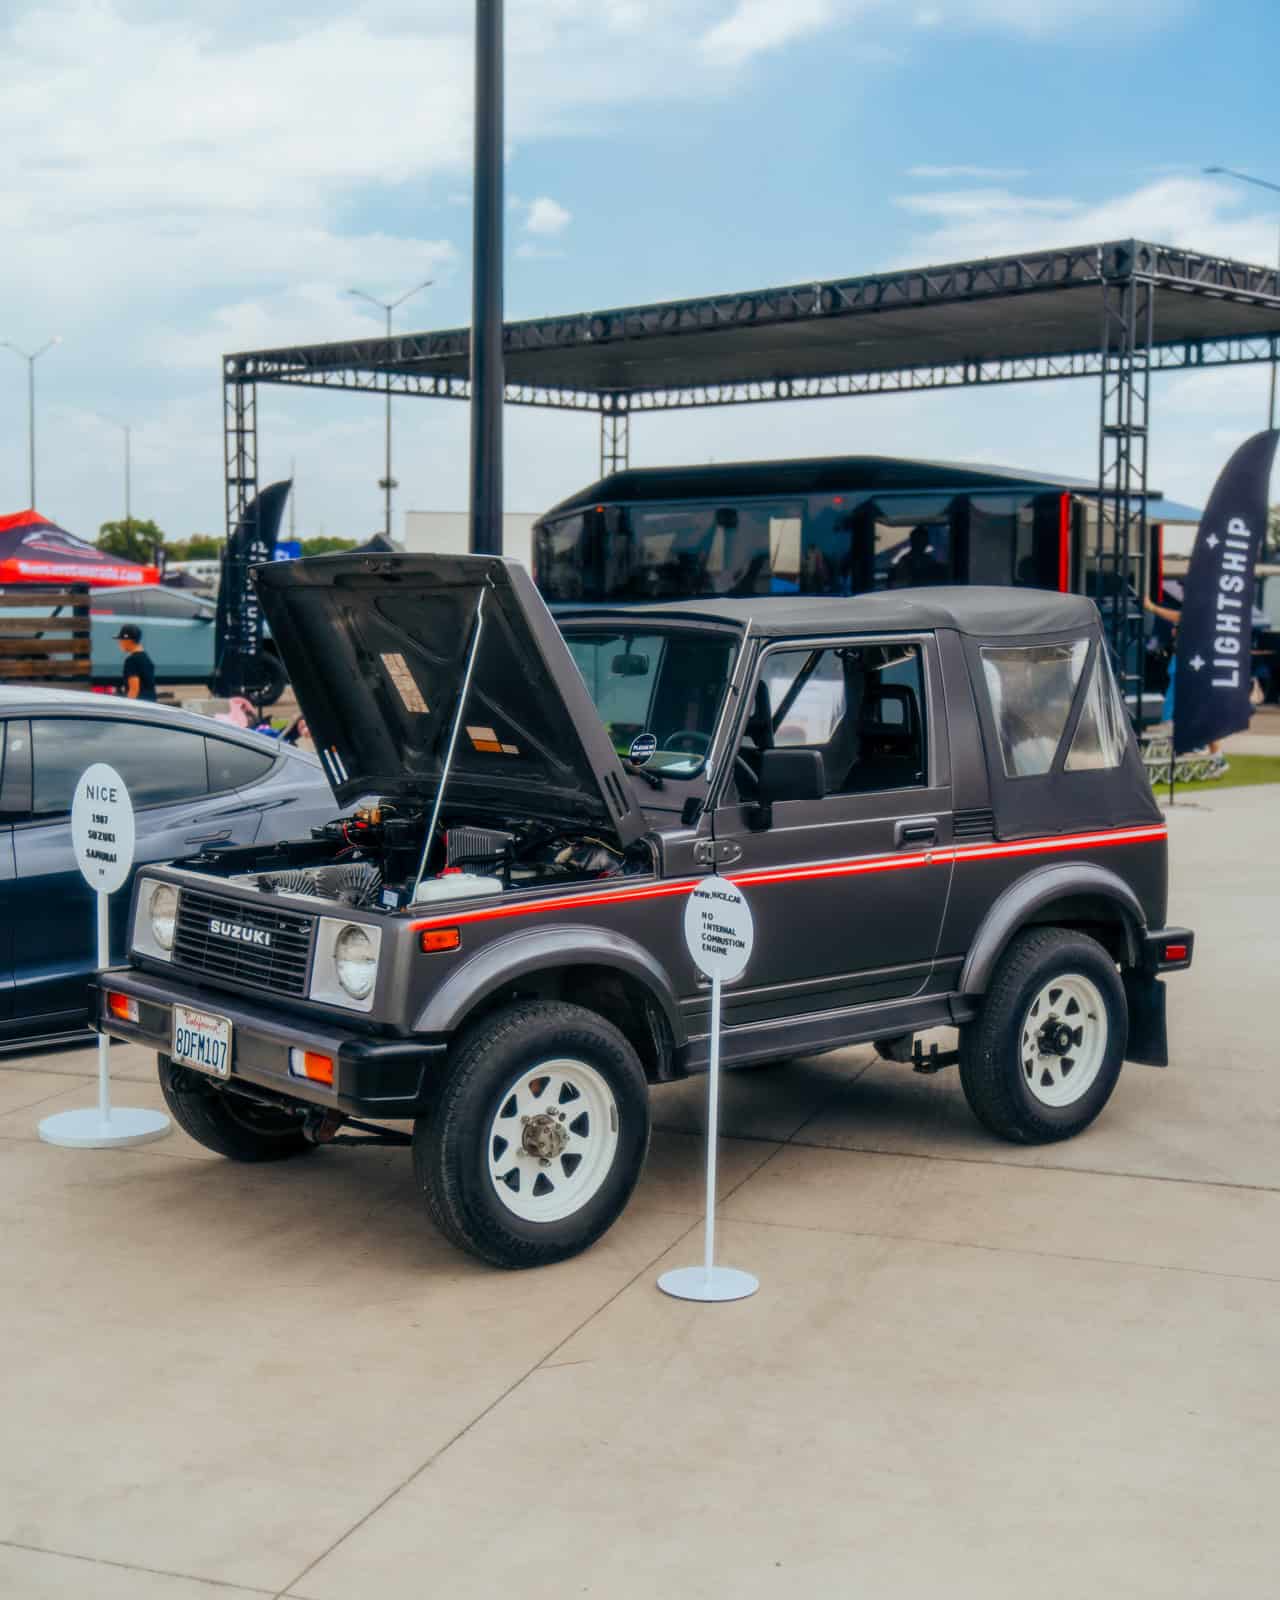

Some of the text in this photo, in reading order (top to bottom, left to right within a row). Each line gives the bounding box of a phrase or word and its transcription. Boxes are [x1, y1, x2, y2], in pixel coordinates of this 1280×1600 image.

[1212, 517, 1251, 688] LIGHTSHIP
[86, 784, 118, 803] NICE
[91, 813, 109, 825] 1987
[87, 829, 116, 843] SUZUKI
[85, 848, 117, 864] SAMURAI
[701, 911, 714, 921] NO
[210, 919, 271, 946] SUZUKI
[703, 922, 736, 937] INTERNAL
[701, 932, 745, 949] COMBUSTION
[702, 943, 727, 956] ENGINE
[176, 1027, 227, 1070] 8DFM107
